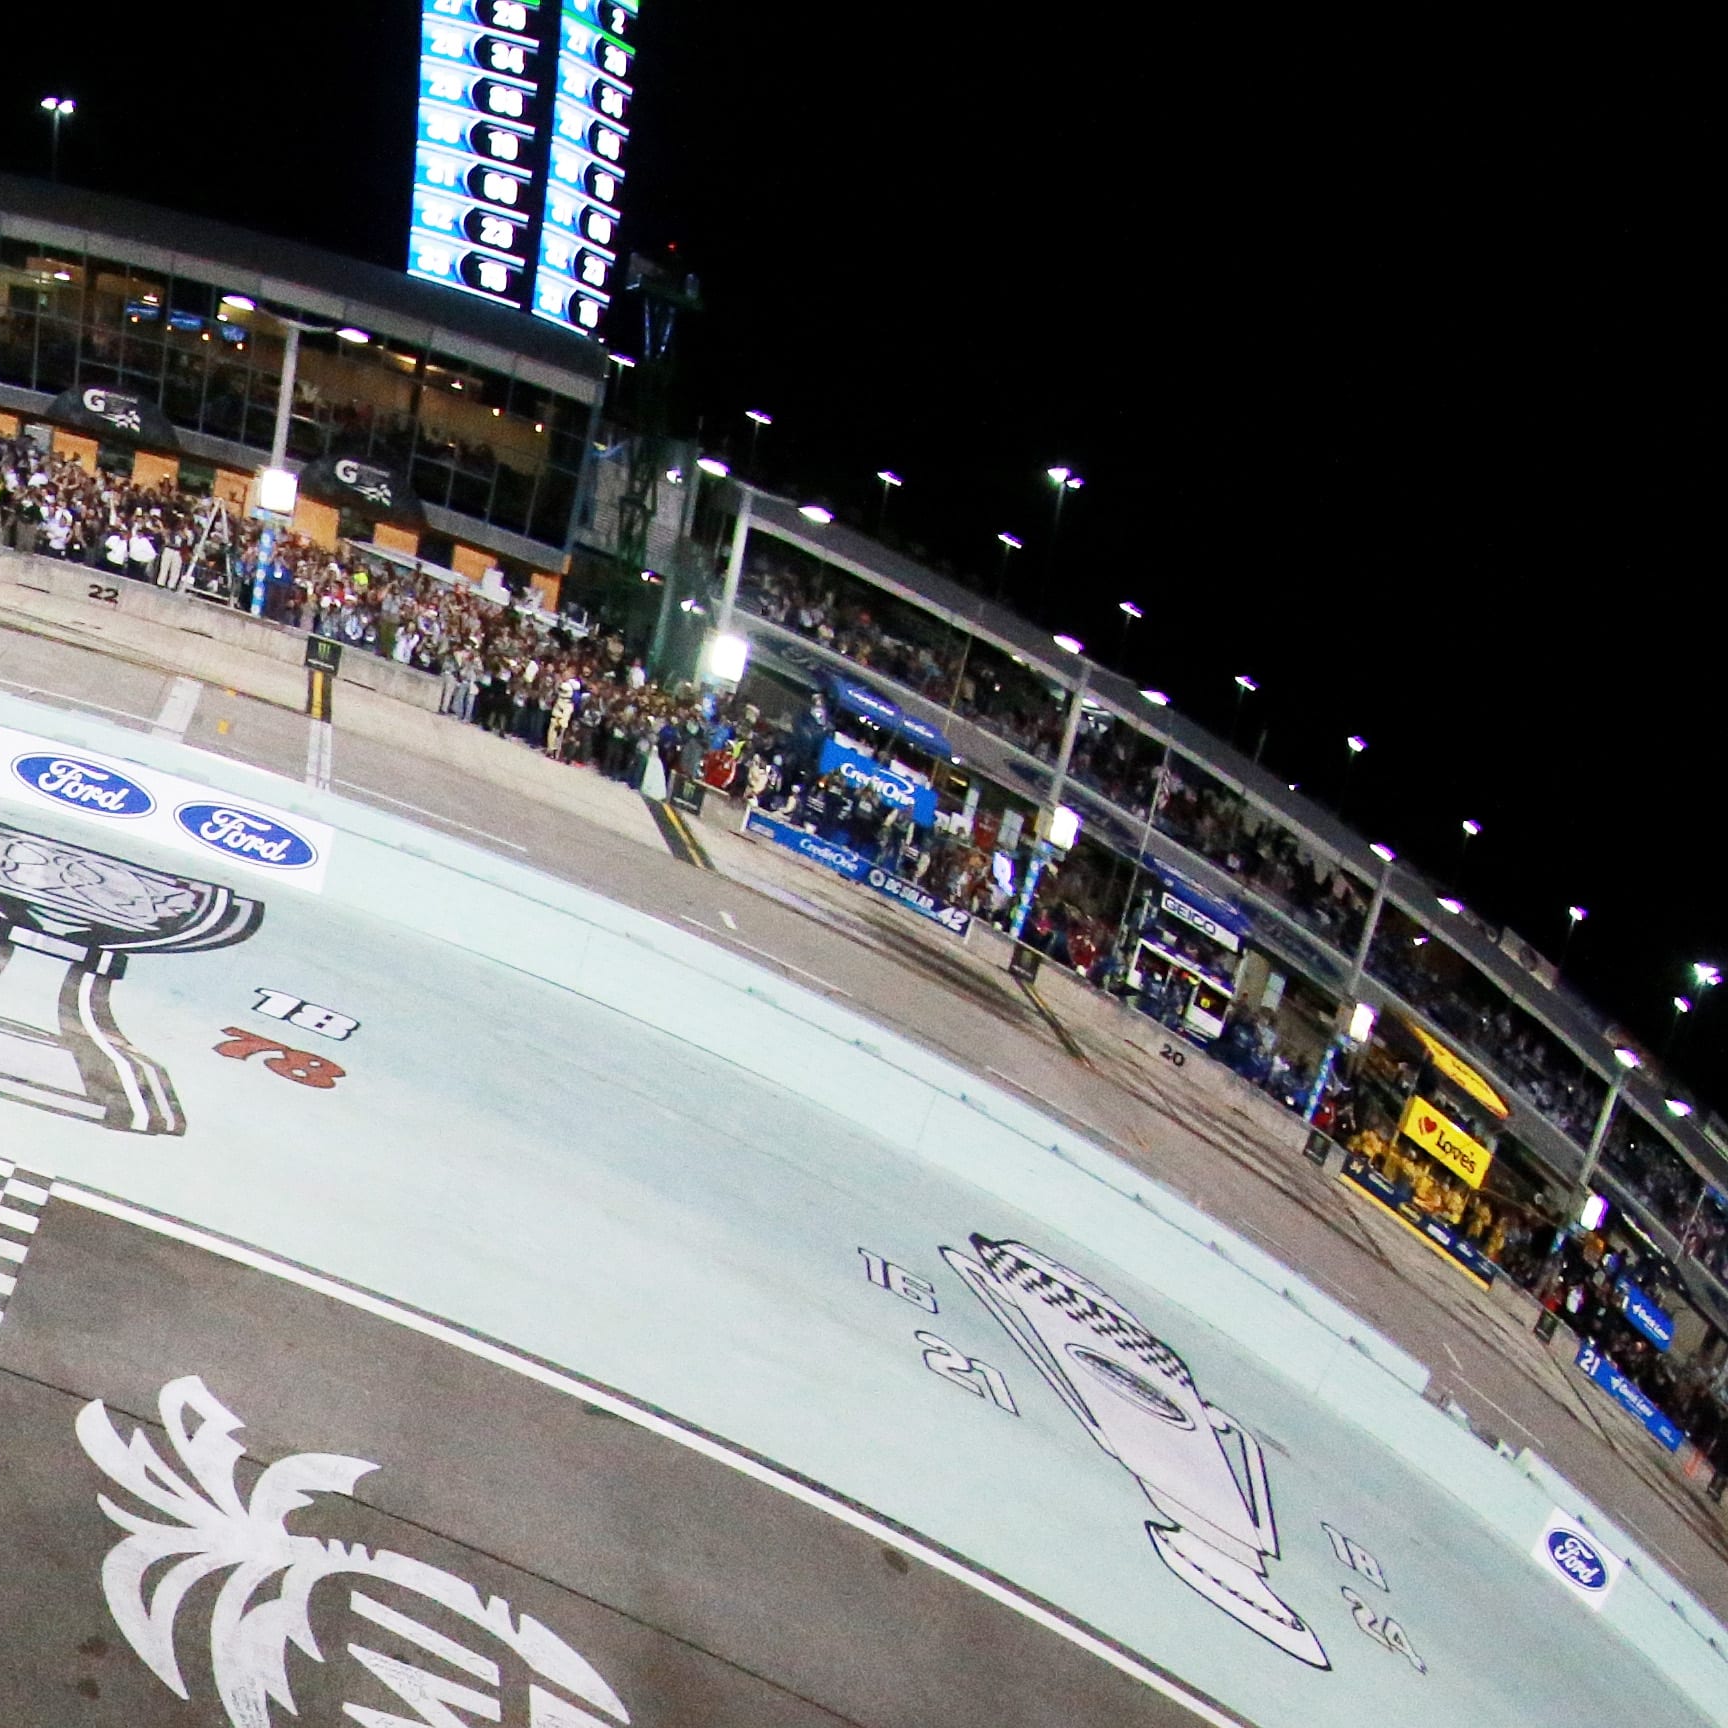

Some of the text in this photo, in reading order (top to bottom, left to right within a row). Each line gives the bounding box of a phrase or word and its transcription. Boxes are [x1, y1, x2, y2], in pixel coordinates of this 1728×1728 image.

[83, 388, 106, 412] G
[335, 460, 359, 484] G
[88, 584, 119, 605] 22
[39, 758, 132, 815] Ford
[200, 806, 292, 865] Ford
[1163, 895, 1218, 936] GEICO
[252, 986, 362, 1042] 18
[211, 1025, 347, 1090] 78
[1158, 1043, 1185, 1068] 20
[857, 1246, 940, 1315] 16
[1579, 1350, 1600, 1377] 21
[1319, 1519, 1391, 1594] 18
[1553, 1534, 1603, 1588] Ford
